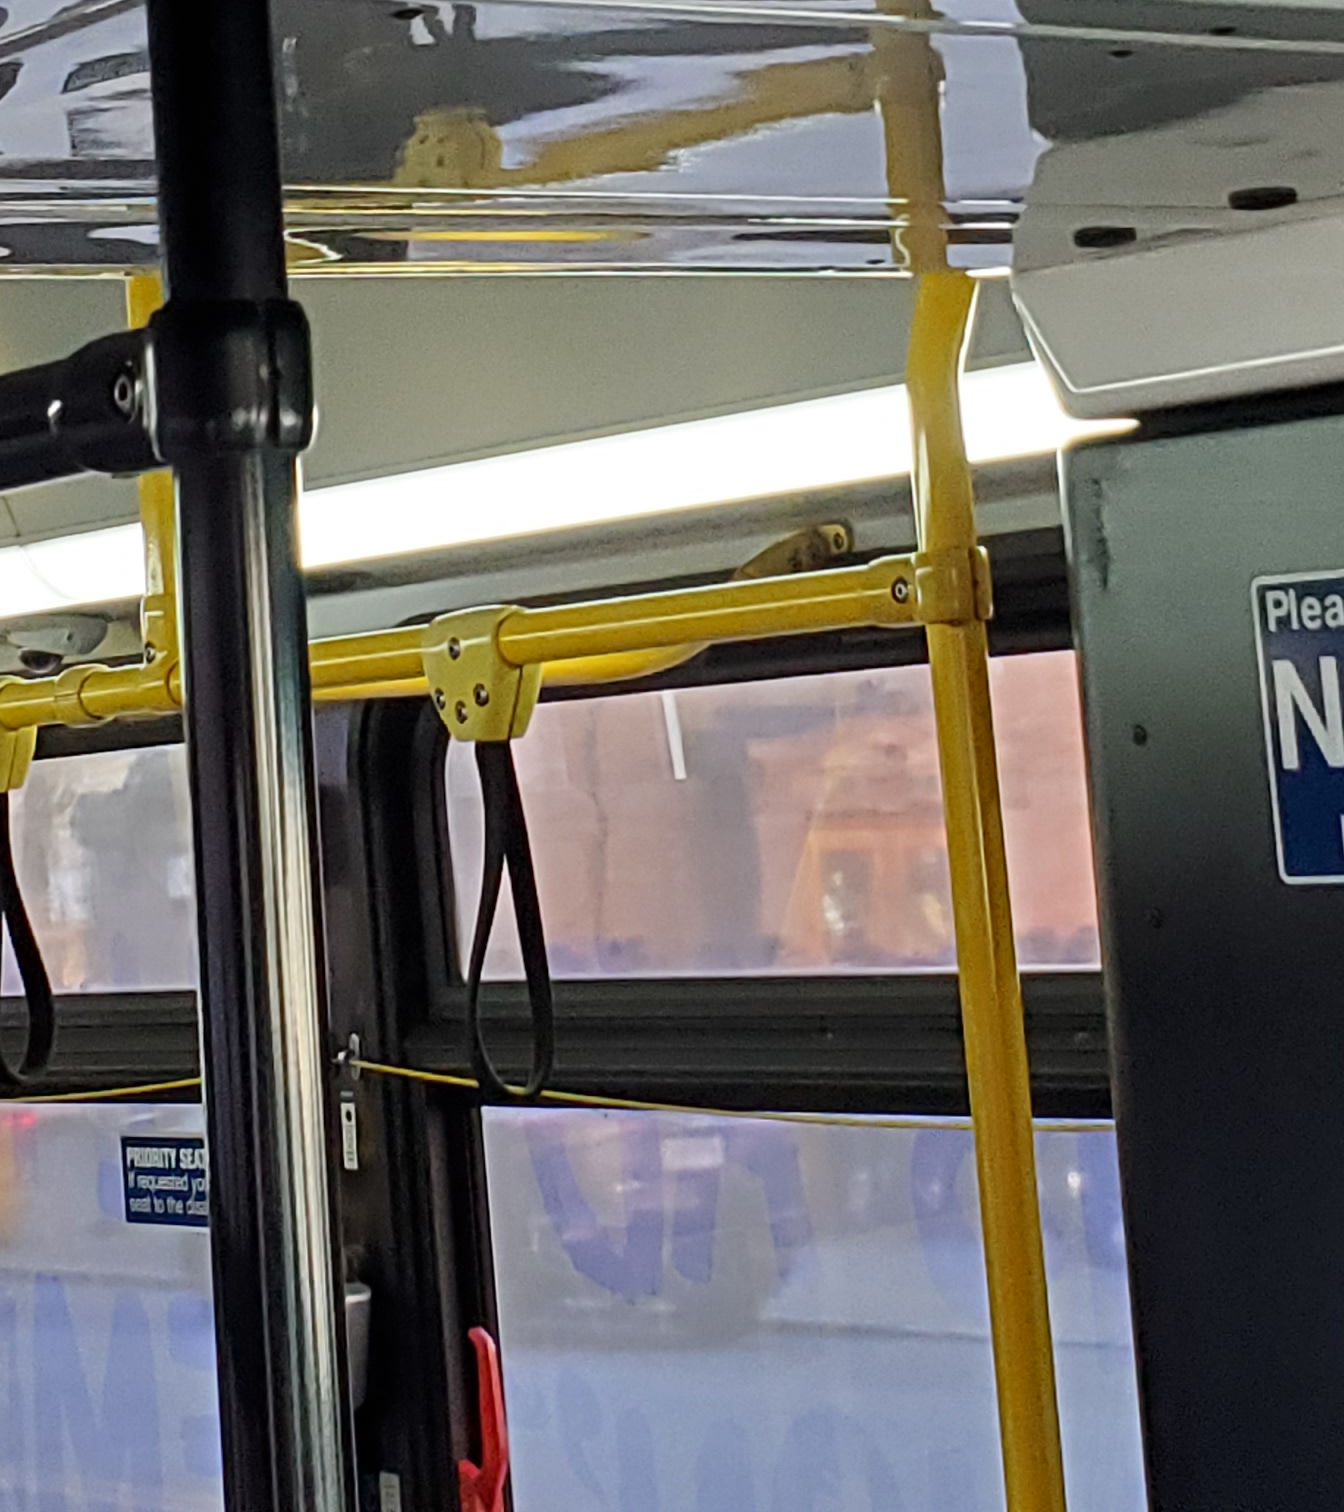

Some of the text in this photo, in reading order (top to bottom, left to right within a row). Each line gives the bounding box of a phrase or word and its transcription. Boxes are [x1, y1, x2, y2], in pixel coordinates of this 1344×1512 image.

[126, 1147, 207, 1169] PRIORITY SEA
[166, 1196, 184, 1213] the
